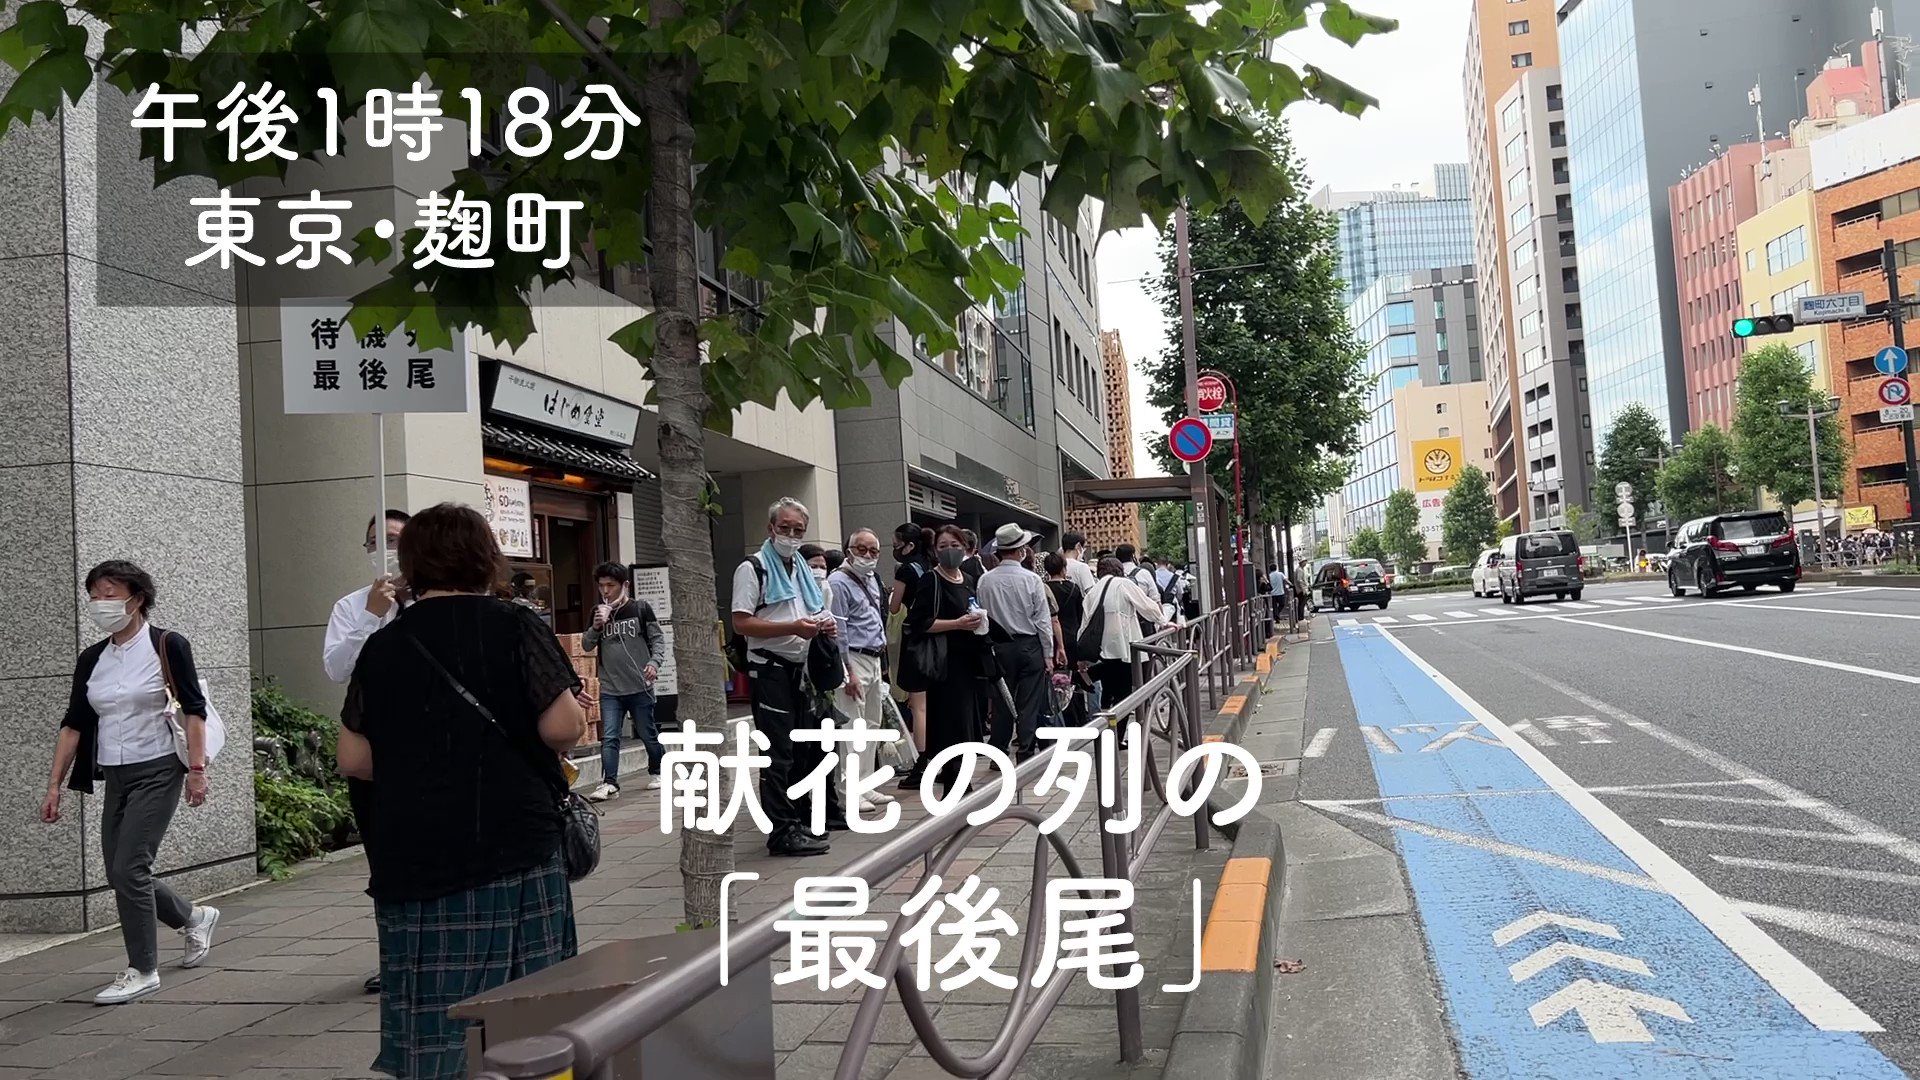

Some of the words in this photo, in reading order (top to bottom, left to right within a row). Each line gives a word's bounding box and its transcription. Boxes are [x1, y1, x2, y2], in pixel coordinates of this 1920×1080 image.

[312, 358, 436, 391] 最後尾
[543, 389, 605, 428] はじめ食堂
